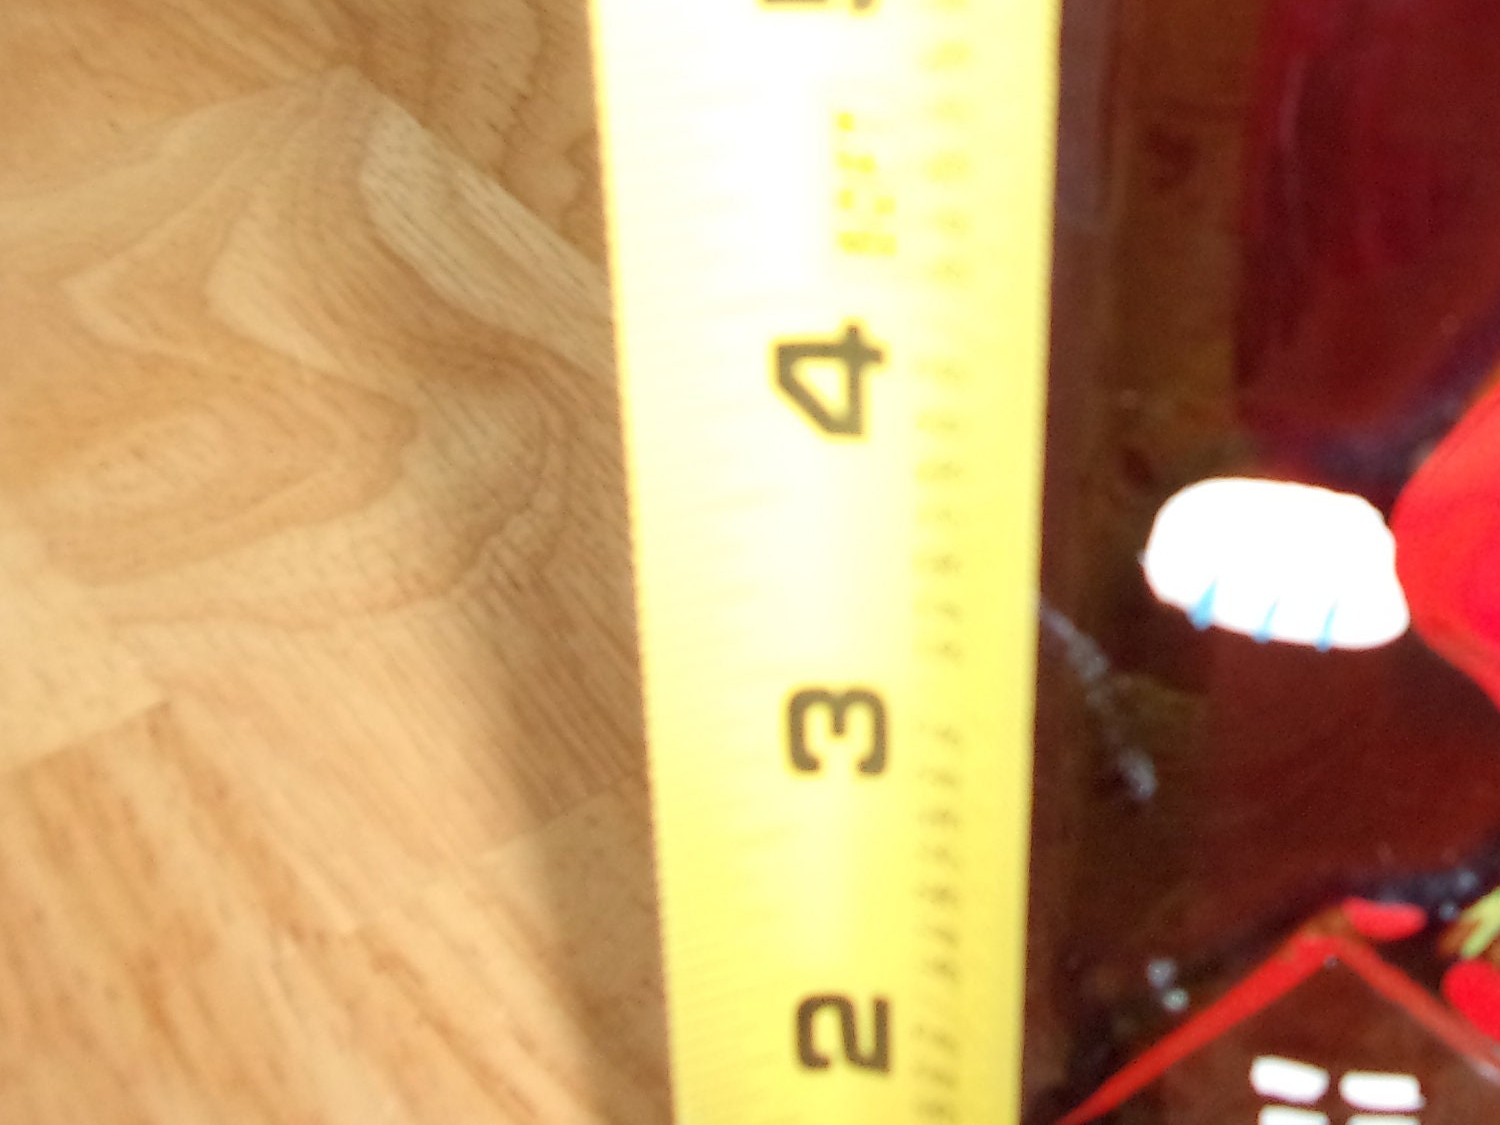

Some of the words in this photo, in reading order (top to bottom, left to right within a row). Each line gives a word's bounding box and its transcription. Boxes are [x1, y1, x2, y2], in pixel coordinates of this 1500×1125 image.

[770, 319, 886, 440] 4
[783, 685, 889, 779] 3
[795, 994, 890, 1074] 2
